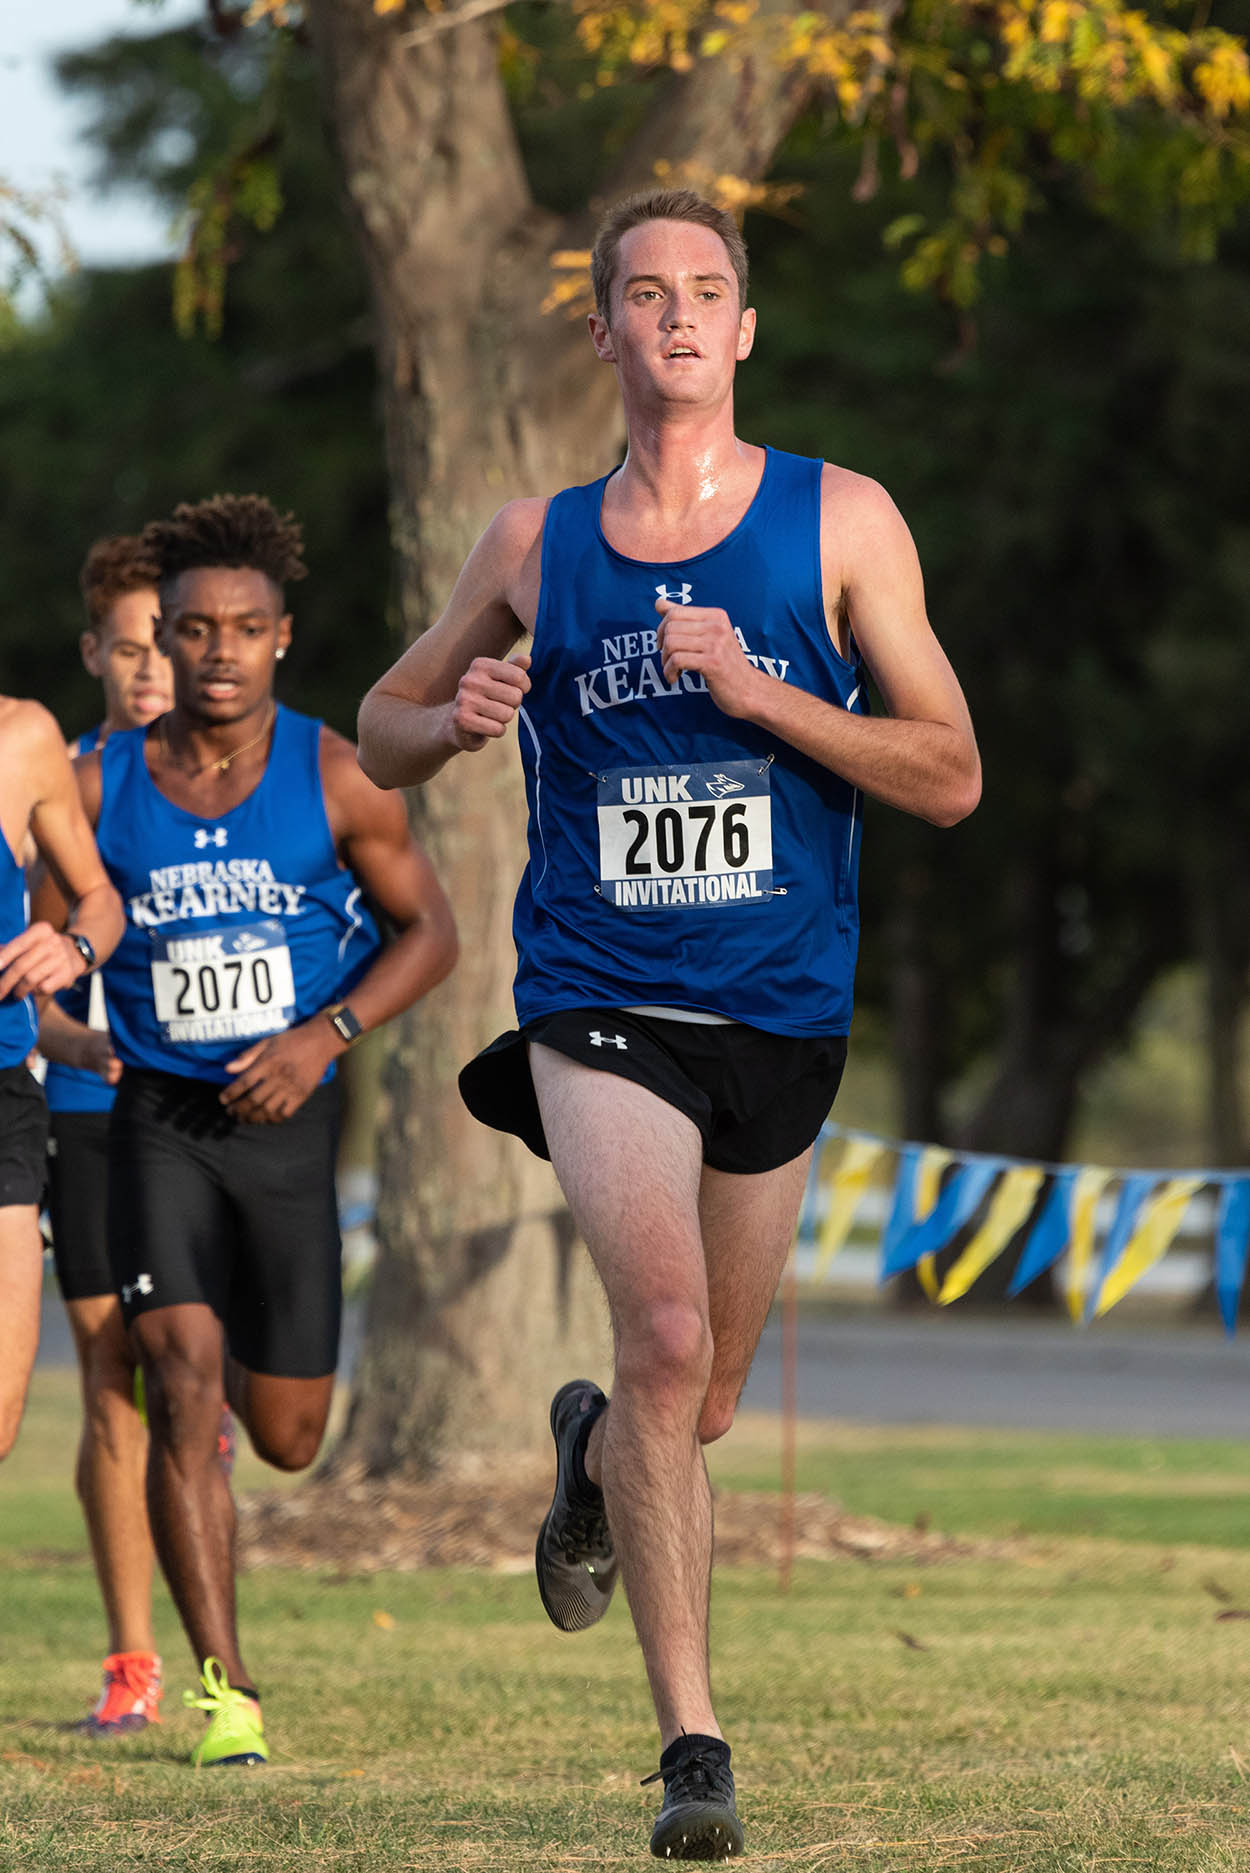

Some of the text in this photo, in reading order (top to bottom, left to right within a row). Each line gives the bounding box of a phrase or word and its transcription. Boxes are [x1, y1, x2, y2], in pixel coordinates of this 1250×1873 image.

[602, 626, 751, 664] NEBA
[621, 775, 693, 804] UNK
[623, 803, 750, 875] 2076
[149, 859, 275, 893] NEBRASKA
[615, 872, 763, 906] INVITATIONAL
[130, 878, 306, 927] KEARNEY
[172, 958, 273, 1015] 2070
